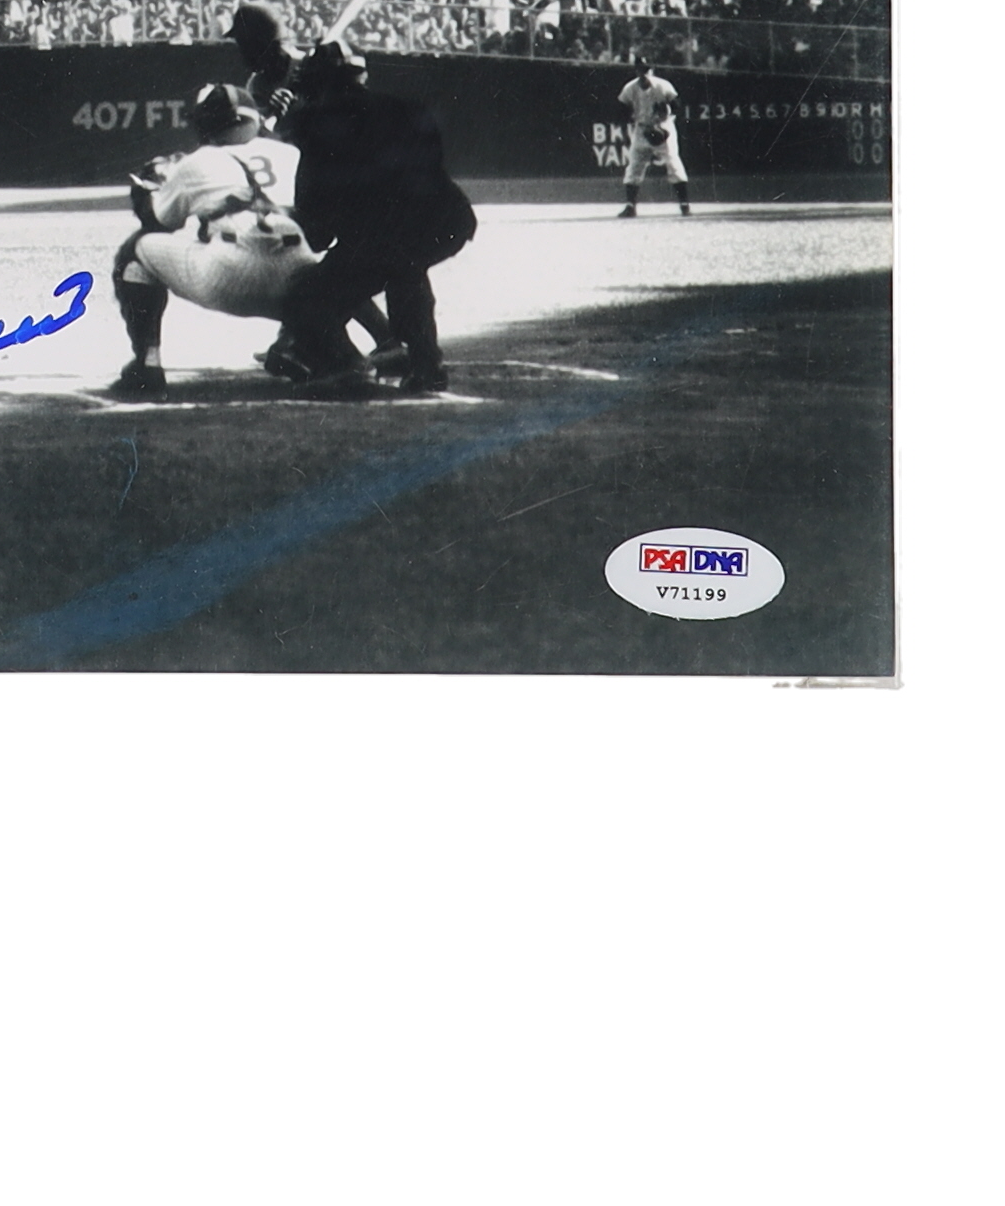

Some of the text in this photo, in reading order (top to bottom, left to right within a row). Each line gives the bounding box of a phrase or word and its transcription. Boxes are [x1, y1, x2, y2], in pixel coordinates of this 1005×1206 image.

[72, 100, 188, 131] 407 FT.
[644, 548, 743, 575] PSA DNA
[656, 586, 727, 602] V71199
